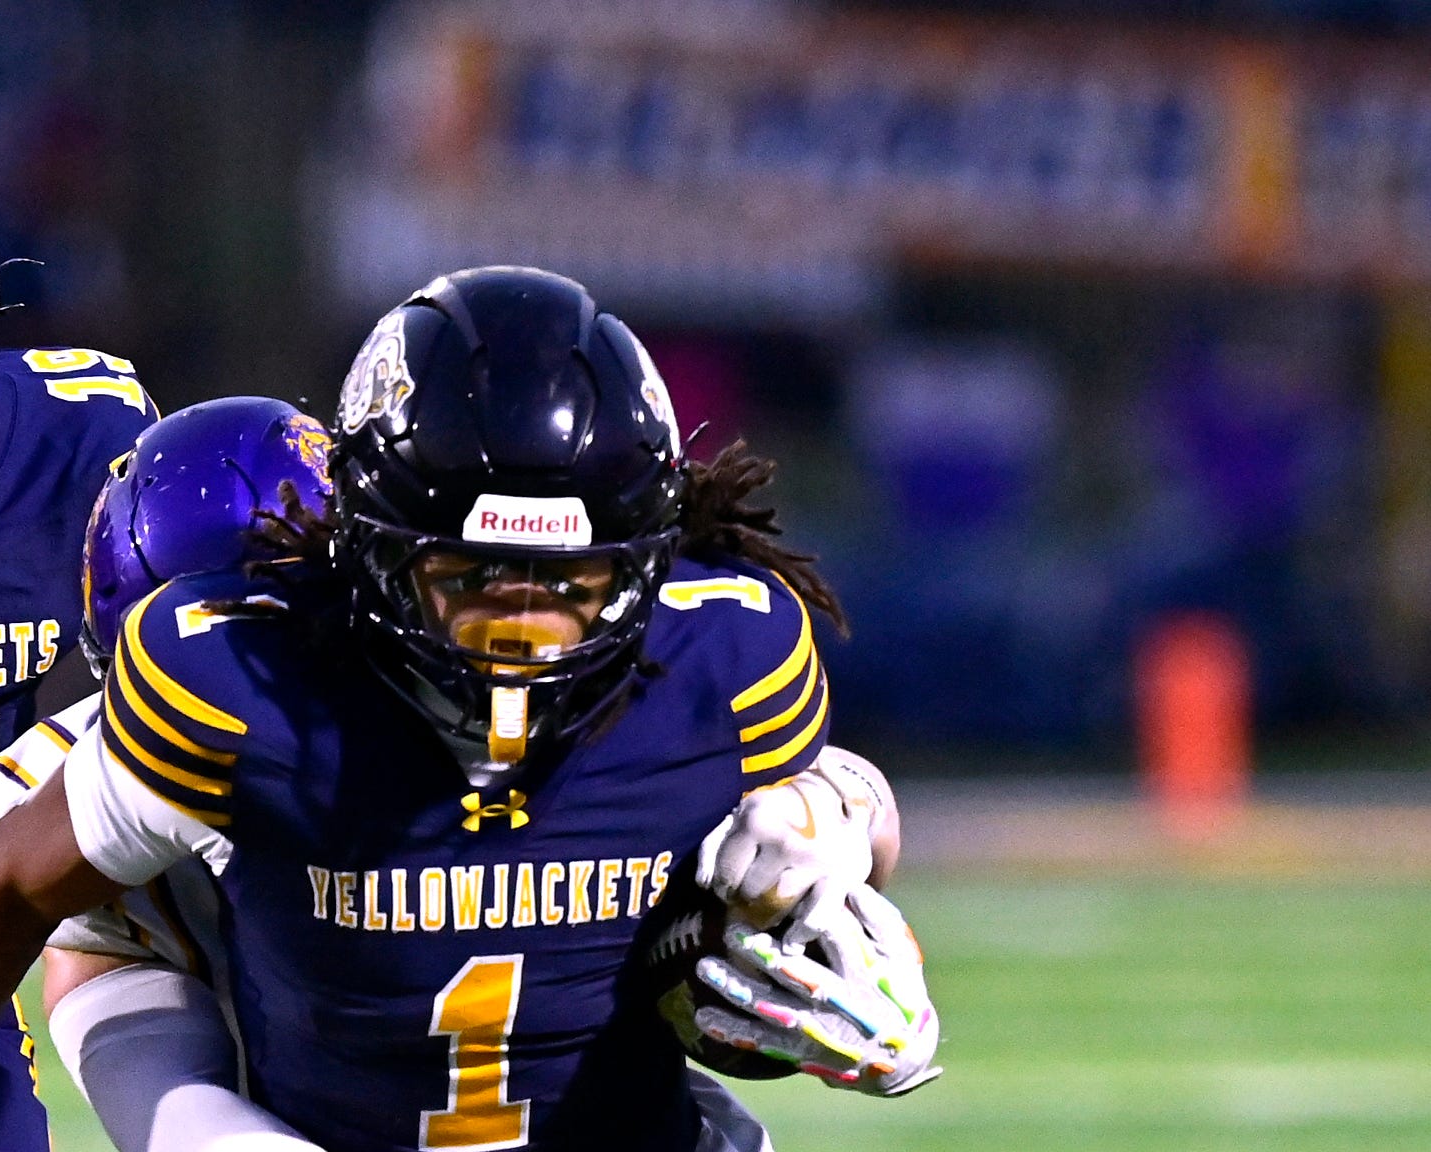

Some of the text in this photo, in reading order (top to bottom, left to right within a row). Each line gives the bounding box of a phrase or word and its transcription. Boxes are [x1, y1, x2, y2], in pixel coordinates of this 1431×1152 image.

[480, 511, 578, 533] Riddell
[658, 575, 772, 614] 1
[307, 850, 673, 932] YELLOWJACKETS
